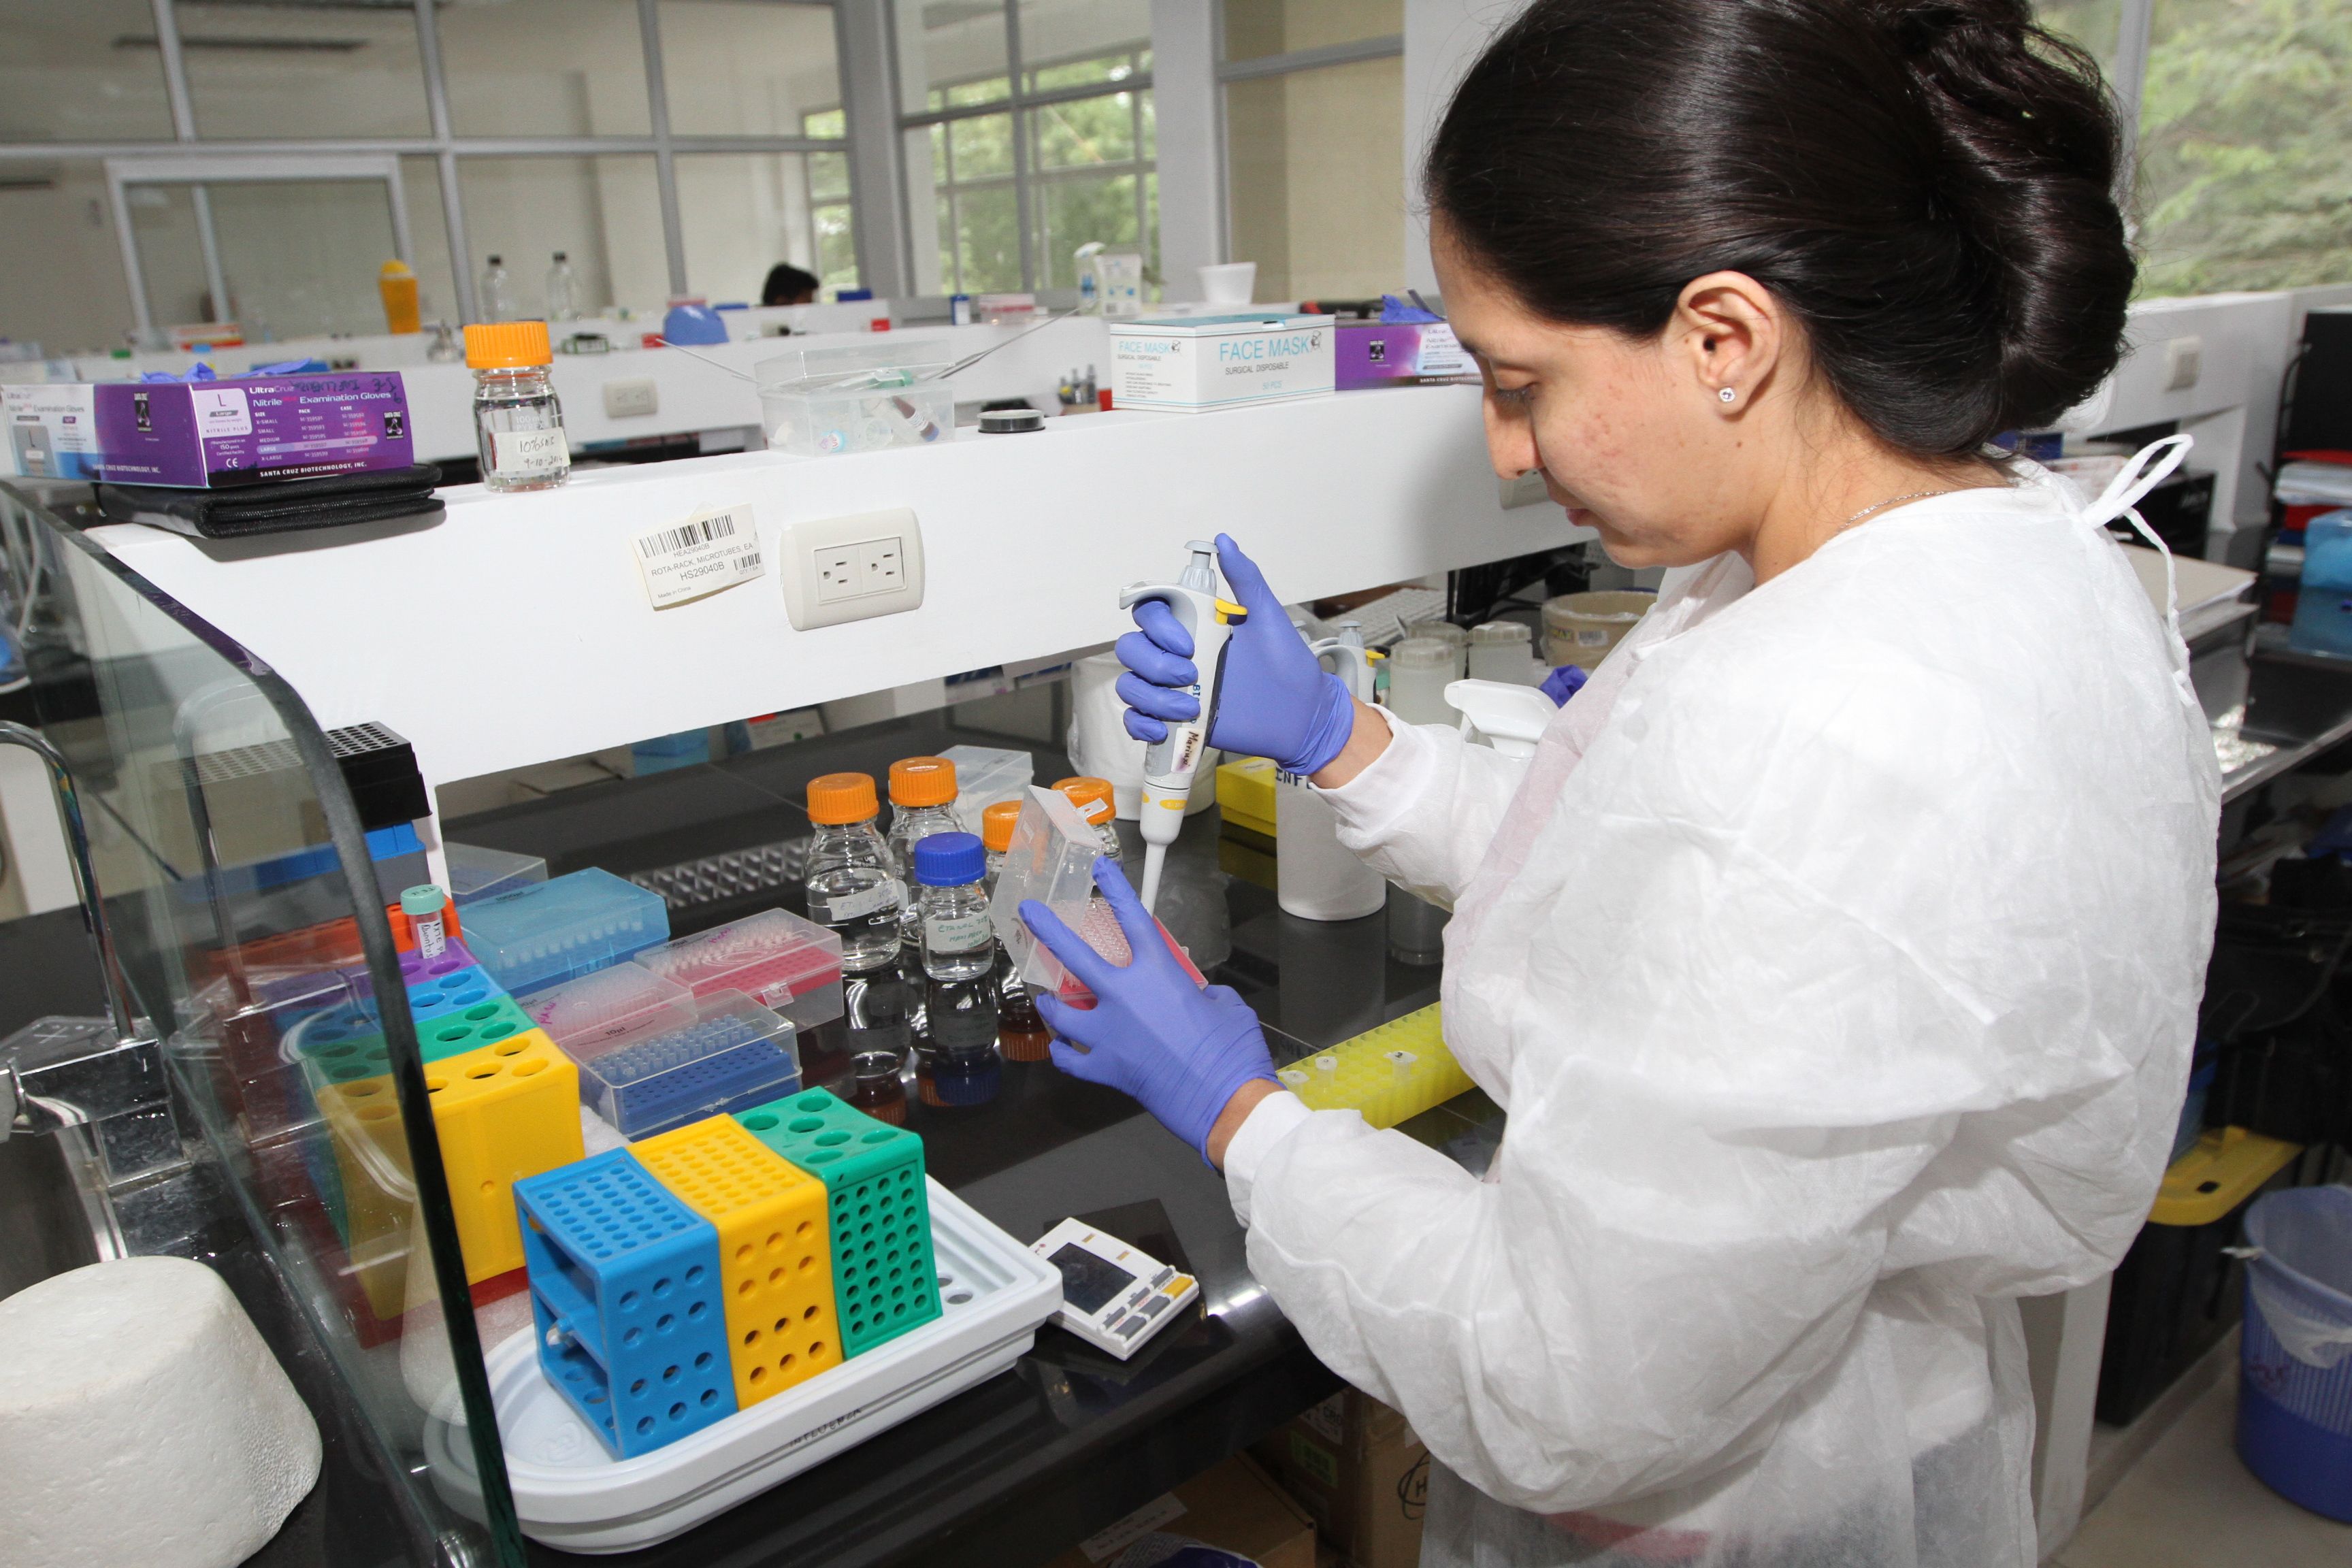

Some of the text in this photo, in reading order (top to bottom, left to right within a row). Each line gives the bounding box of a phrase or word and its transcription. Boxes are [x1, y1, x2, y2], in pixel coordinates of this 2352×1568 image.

[1118, 341, 1170, 354] FACE MASK
[1220, 336, 1310, 361] FACE MASK
[1225, 361, 1289, 375] SURGICAL DISPOSABLE
[249, 386, 295, 395] UltraCruz
[218, 393, 227, 407] L
[252, 399, 282, 408] Nitrile
[299, 393, 359, 404] Examination
[361, 392, 391, 400] Gloves
[301, 463, 353, 474] BIOTECHNOLOGY,
[673, 543, 710, 558] HEA29040B
[651, 559, 696, 577] ROTA-RACK,
[744, 542, 754, 551] EA
[680, 561, 725, 581] HS29040B
[657, 591, 672, 599] Made
[789, 1409, 862, 1448] INFLUENZA
